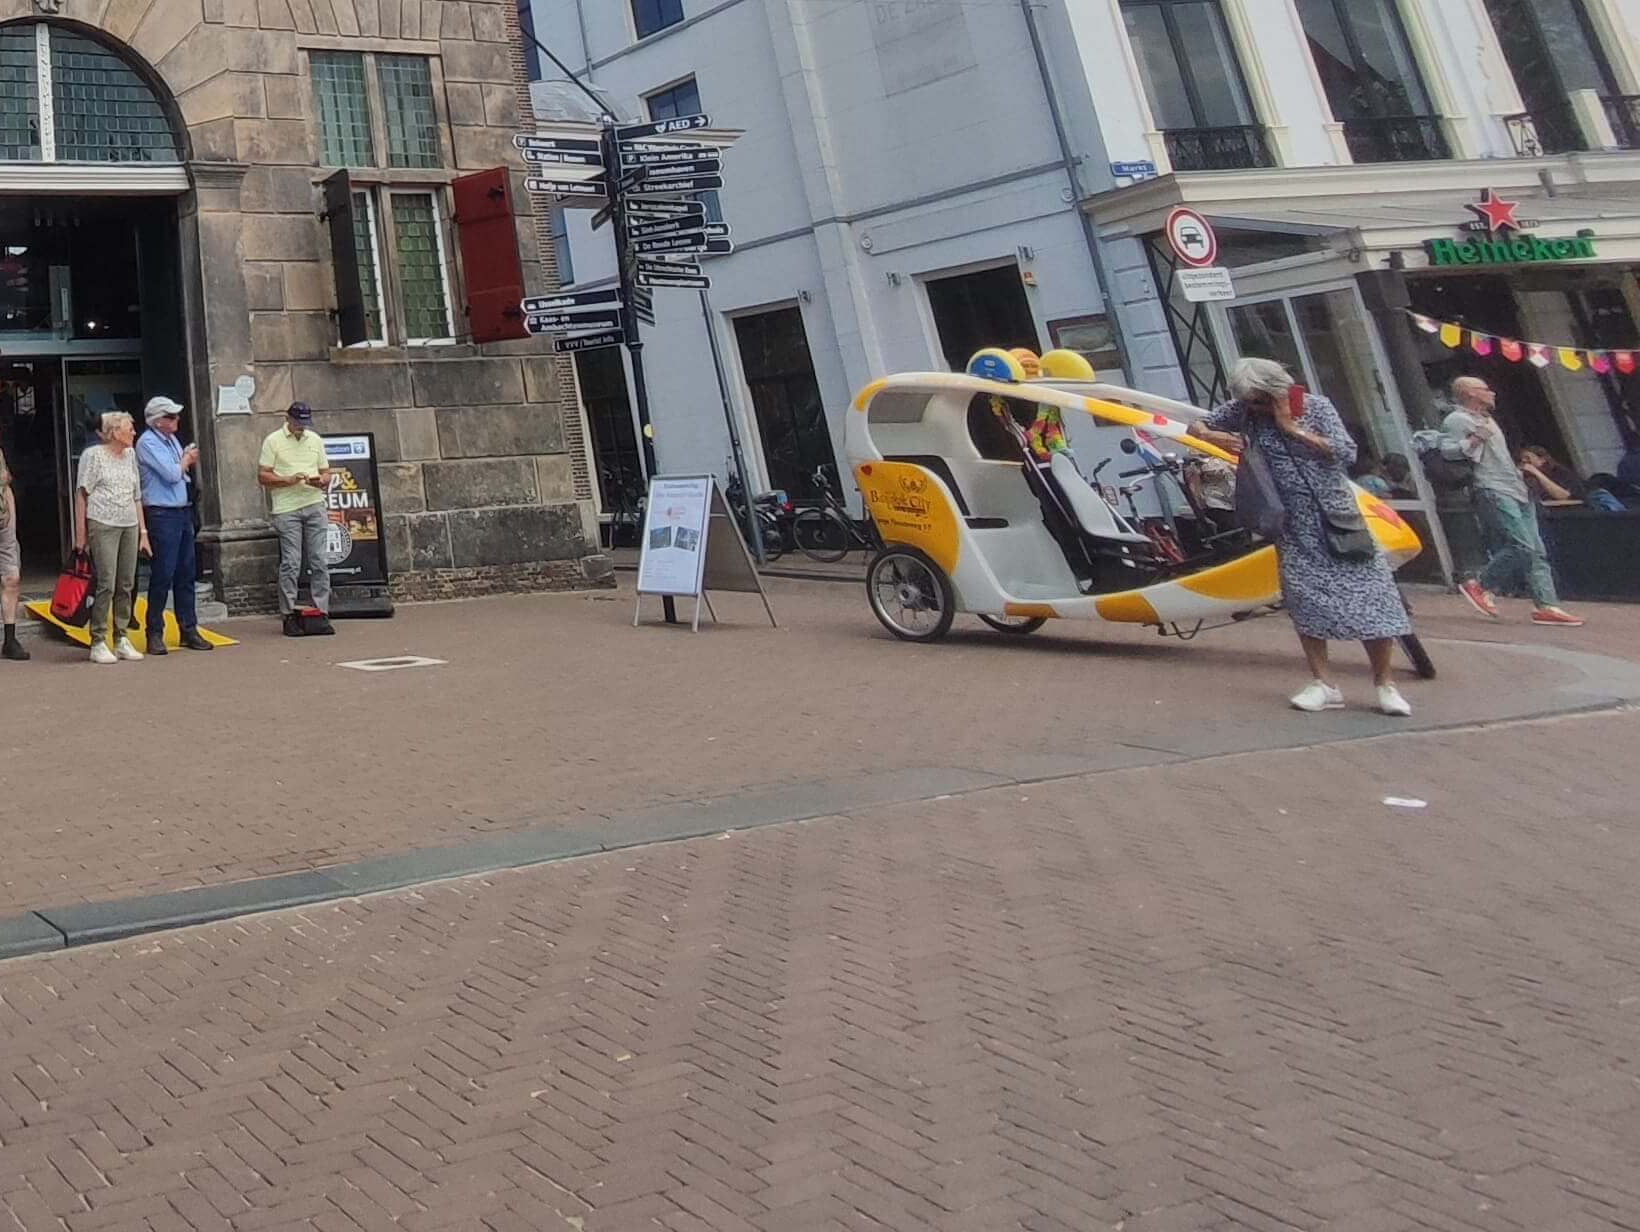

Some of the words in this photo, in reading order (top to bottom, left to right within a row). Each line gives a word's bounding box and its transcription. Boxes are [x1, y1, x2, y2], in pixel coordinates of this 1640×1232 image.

[668, 119, 690, 131] AED
[661, 152, 693, 161] Amerika
[1430, 235, 1597, 267] Heineken
[325, 491, 369, 510] EUM
